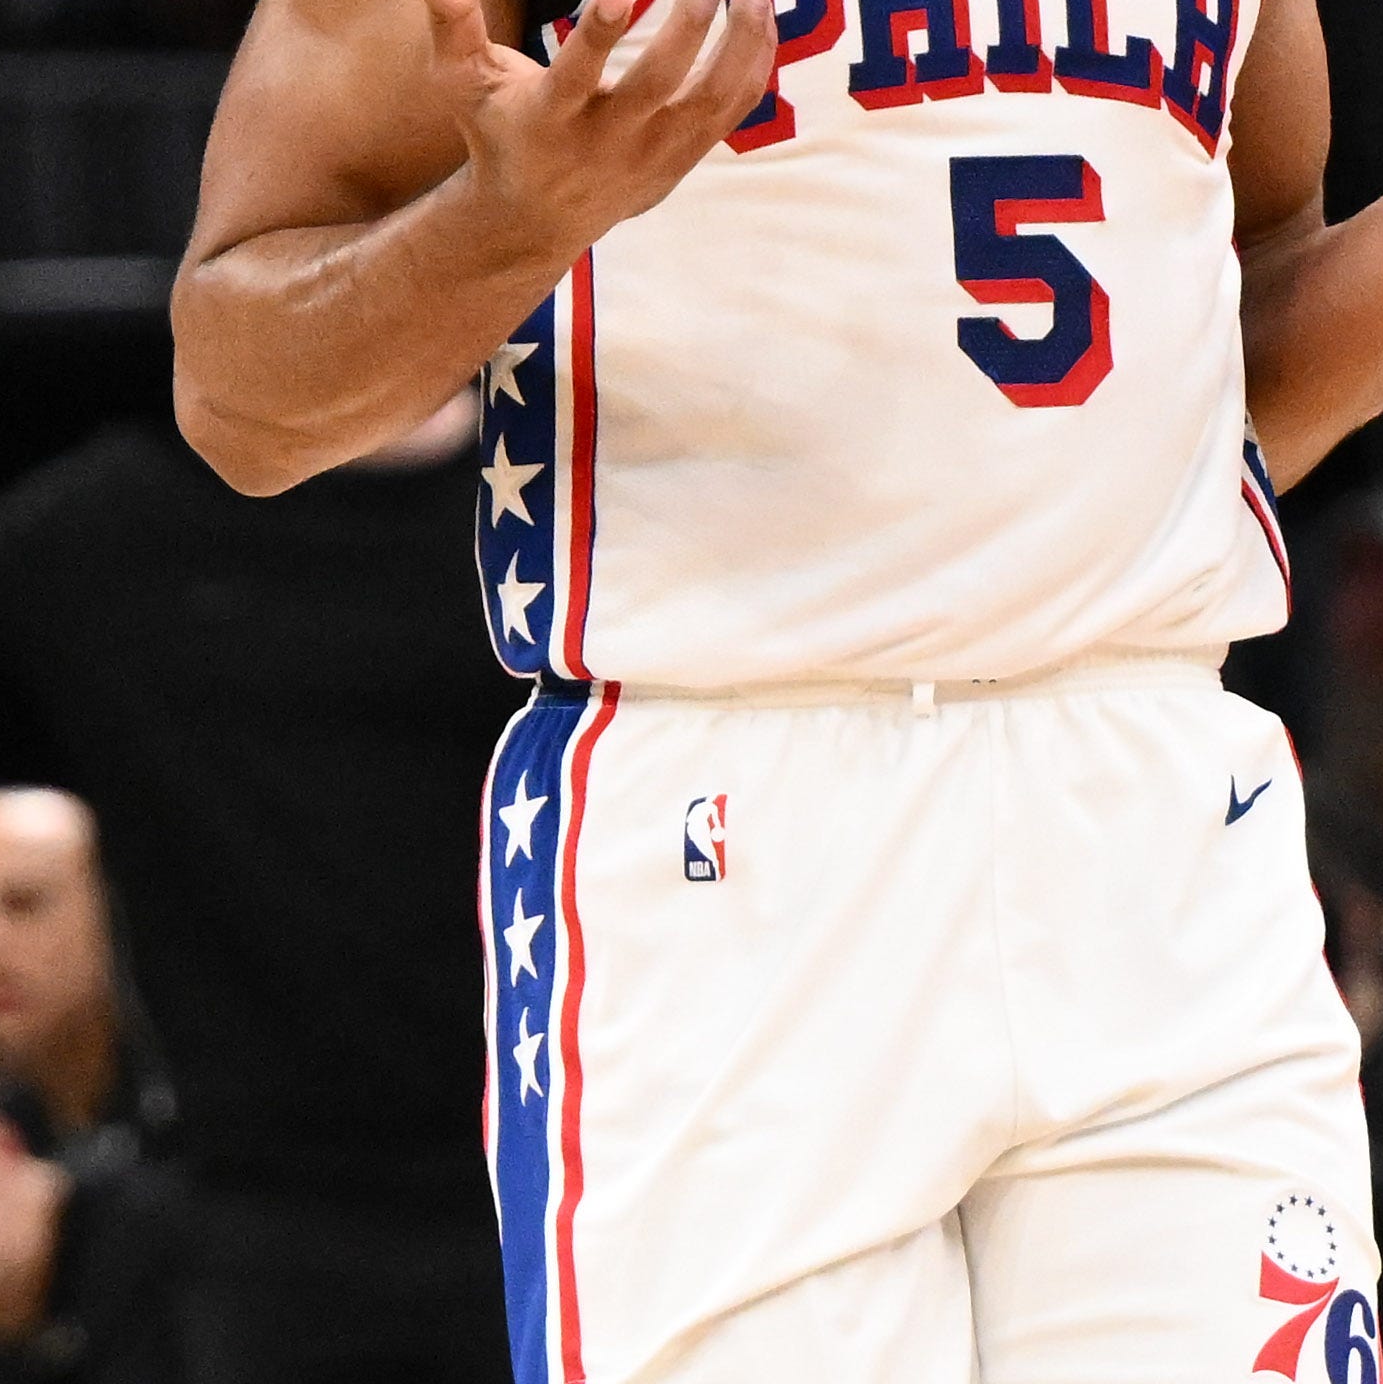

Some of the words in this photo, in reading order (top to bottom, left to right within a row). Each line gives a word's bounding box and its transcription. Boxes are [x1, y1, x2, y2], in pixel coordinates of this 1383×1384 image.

[949, 155, 1114, 408] 5
[689, 861, 711, 877] NBA
[1252, 1251, 1377, 1383] 76
